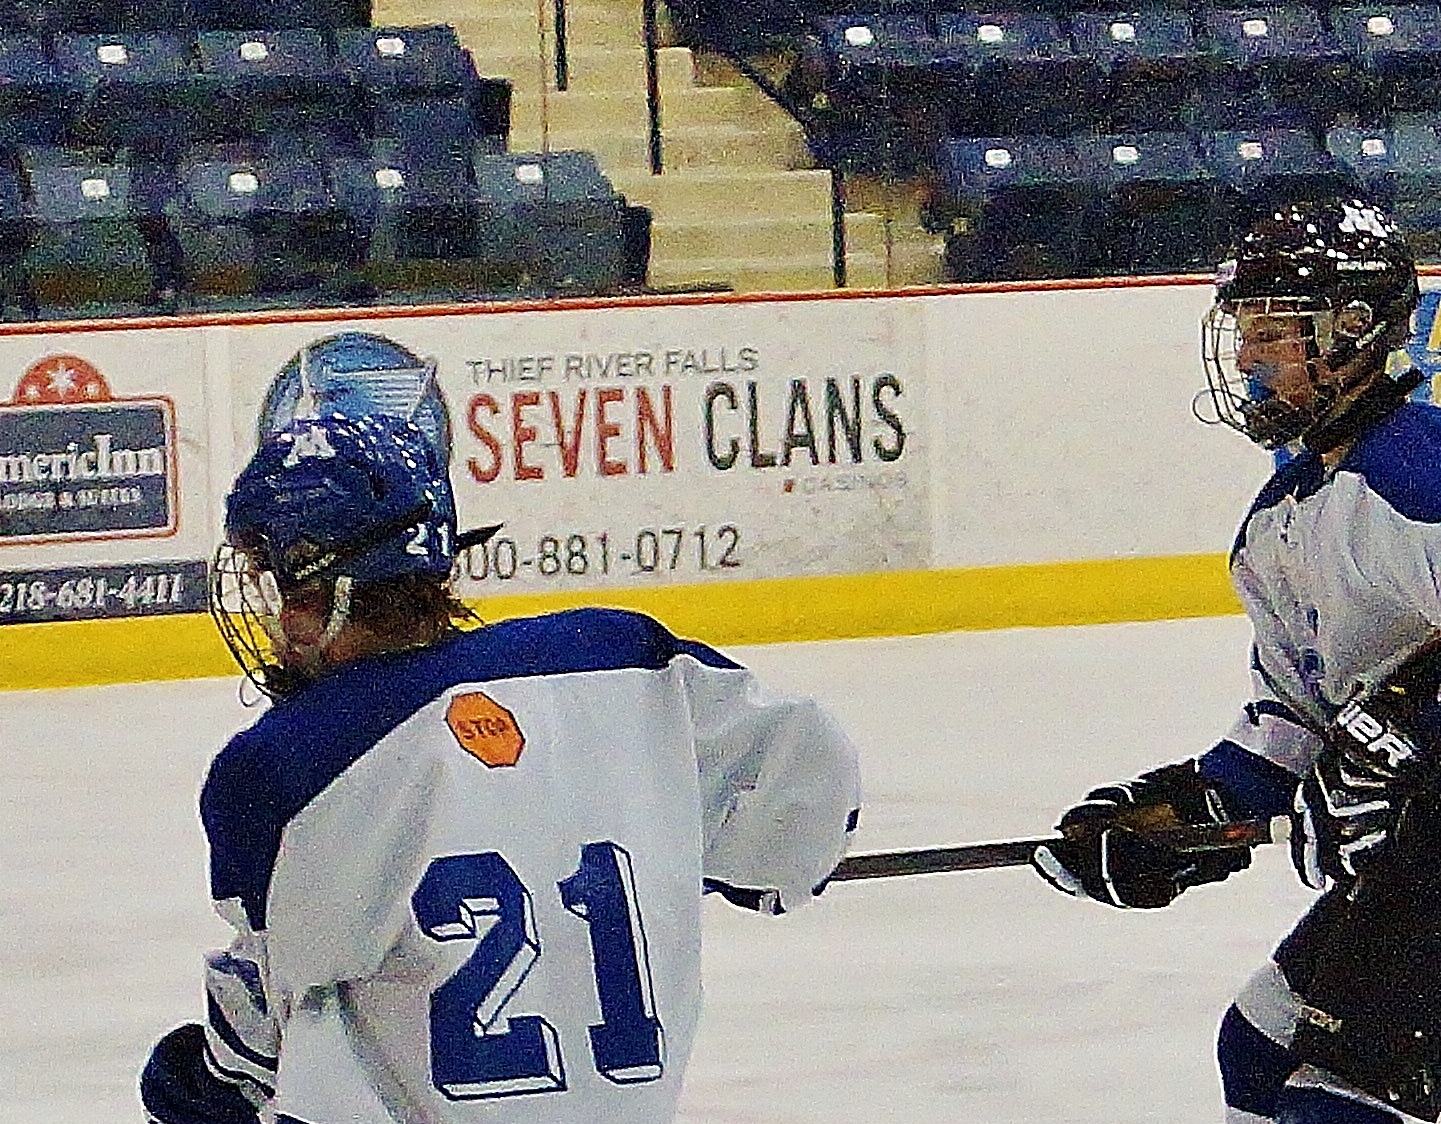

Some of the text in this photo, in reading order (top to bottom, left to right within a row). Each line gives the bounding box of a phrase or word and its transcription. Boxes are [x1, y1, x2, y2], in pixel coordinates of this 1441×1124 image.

[466, 347, 760, 385] THIEF RIVER FALLS
[466, 372, 906, 483] SEVEN CLANS
[452, 524, 743, 581] 00-881-0712
[410, 840, 666, 1101] 21
